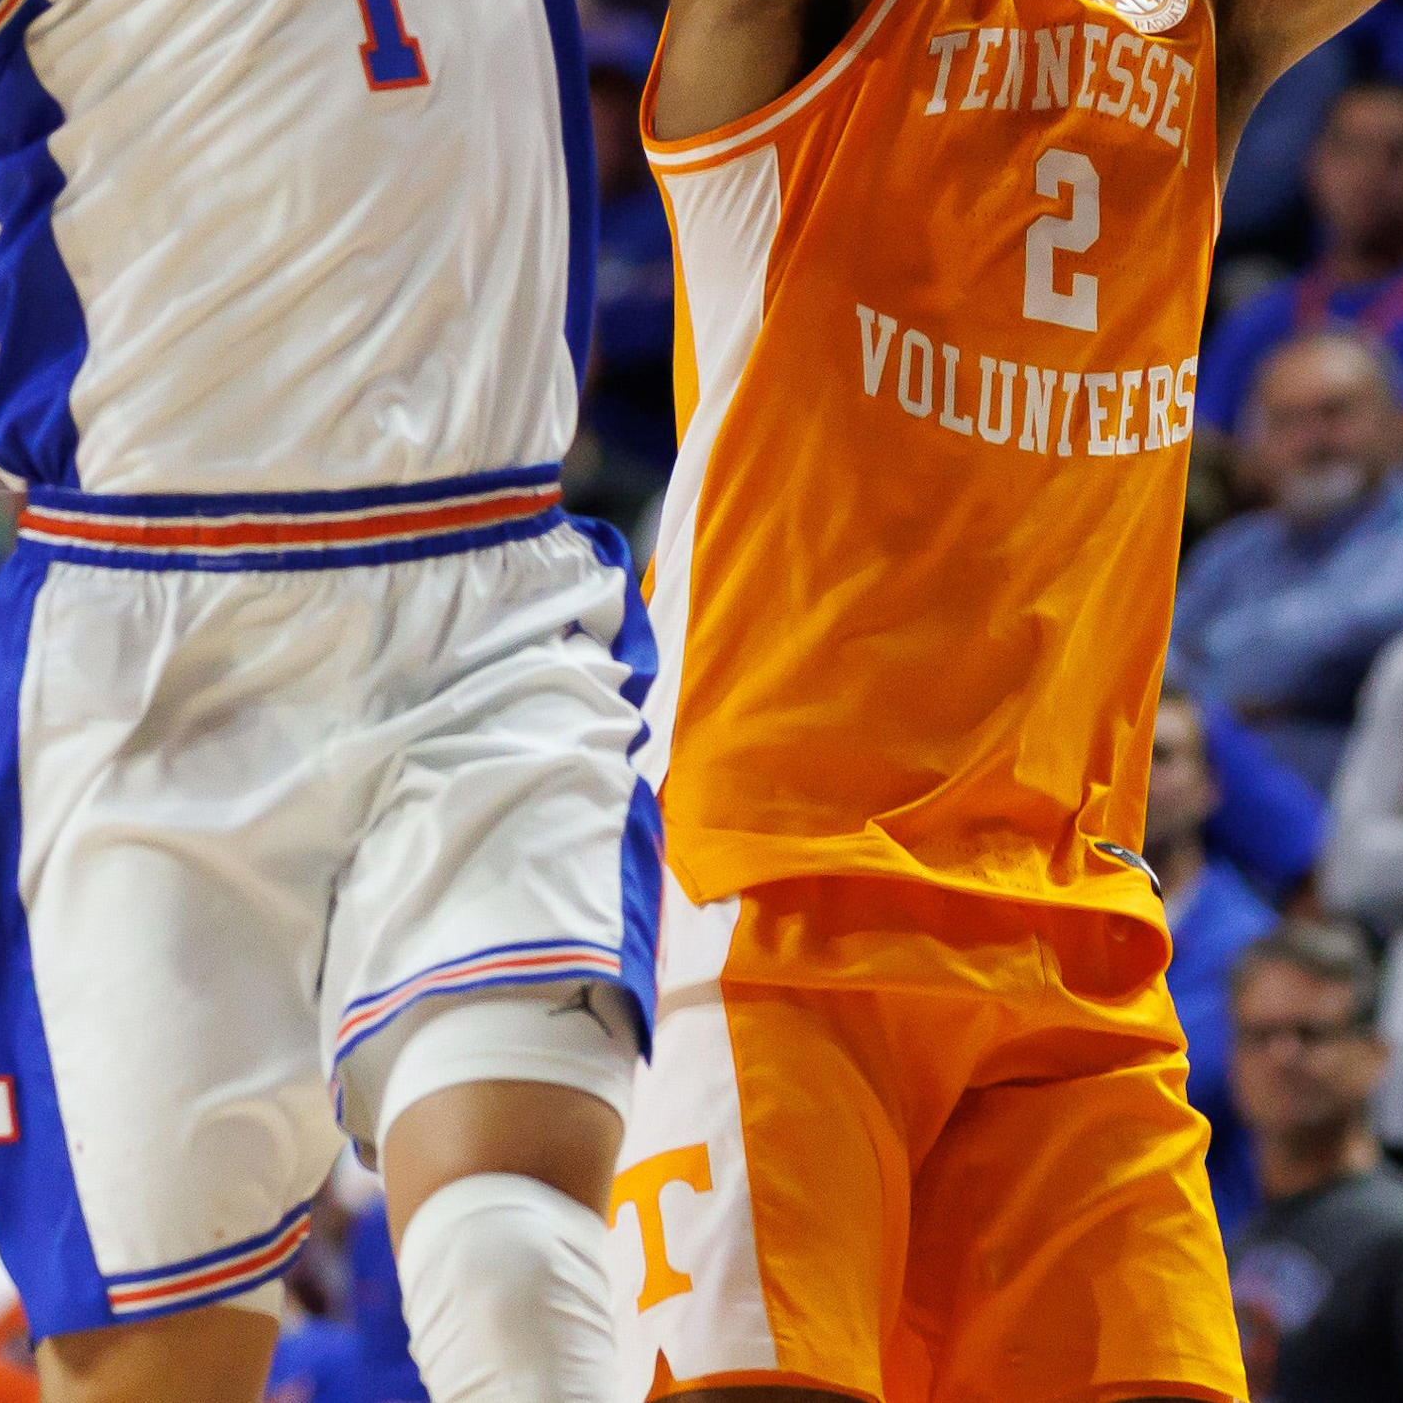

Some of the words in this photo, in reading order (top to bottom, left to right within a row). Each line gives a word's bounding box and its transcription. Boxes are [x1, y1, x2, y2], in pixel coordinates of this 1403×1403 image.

[924, 22, 1195, 160] TENNESSE
[1023, 148, 1100, 333] 2
[856, 302, 1198, 457] VOLUNTEERS
[606, 1141, 713, 1315] T
